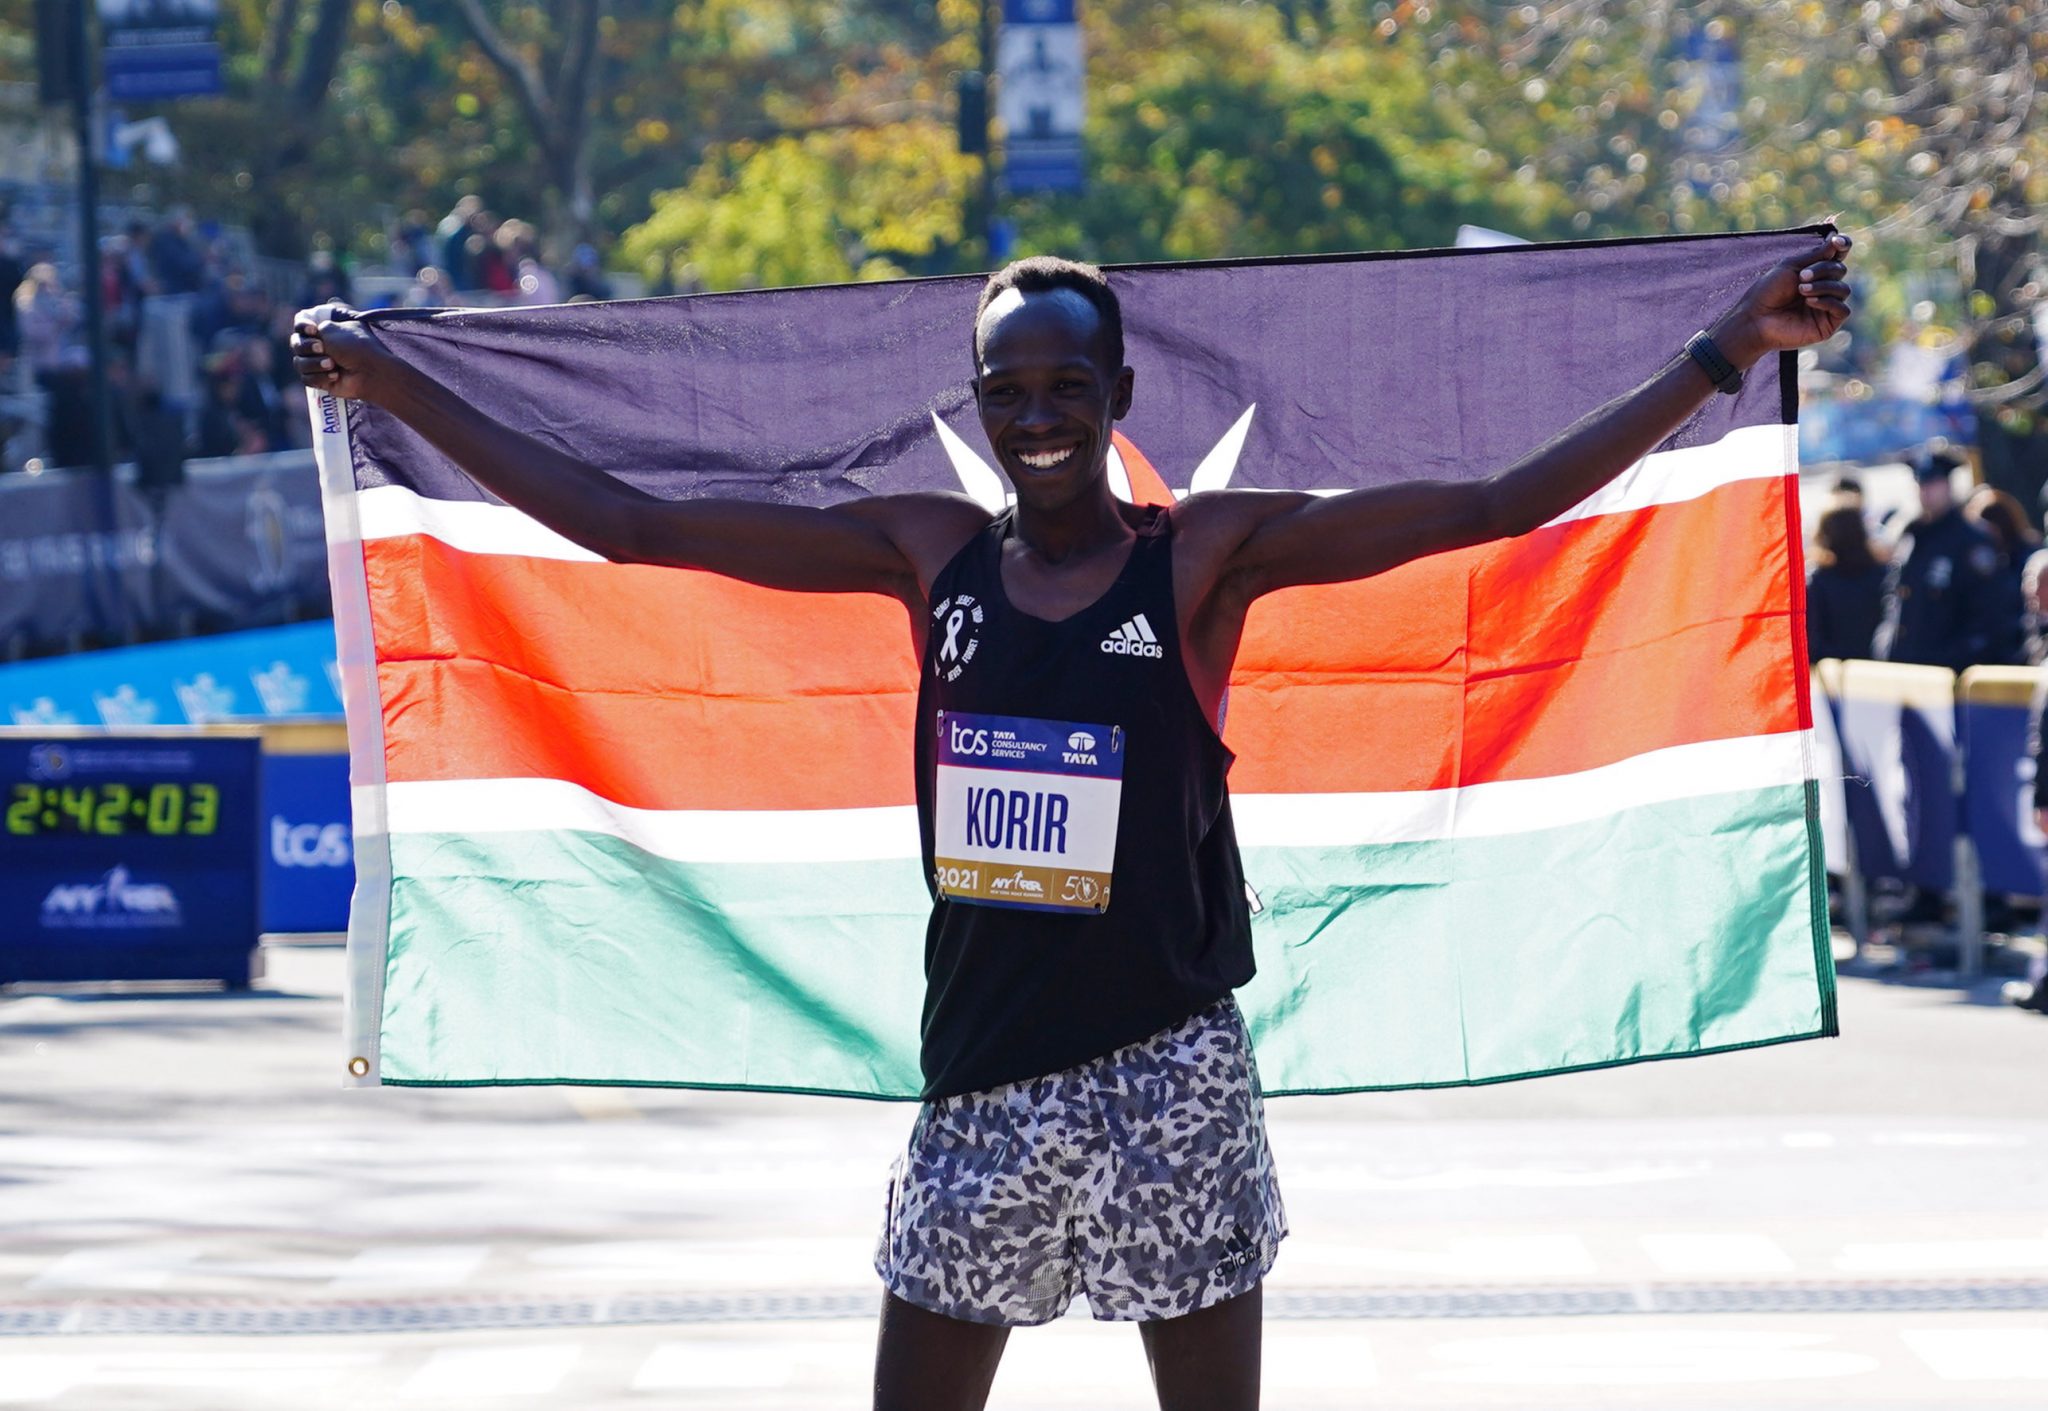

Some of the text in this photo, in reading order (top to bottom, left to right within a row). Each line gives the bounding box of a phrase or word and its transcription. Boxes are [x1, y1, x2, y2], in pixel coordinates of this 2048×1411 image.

[1100, 637, 1163, 659] adidas
[951, 720, 988, 756] tcs
[991, 740, 1048, 752] CONSULTANCY
[992, 731, 1016, 740] TATA
[991, 749, 1026, 759] SERVICES
[1062, 752, 1098, 766] TATA
[966, 786, 1069, 854] KORIR
[270, 814, 352, 868] tcs
[937, 867, 979, 890] 2021
